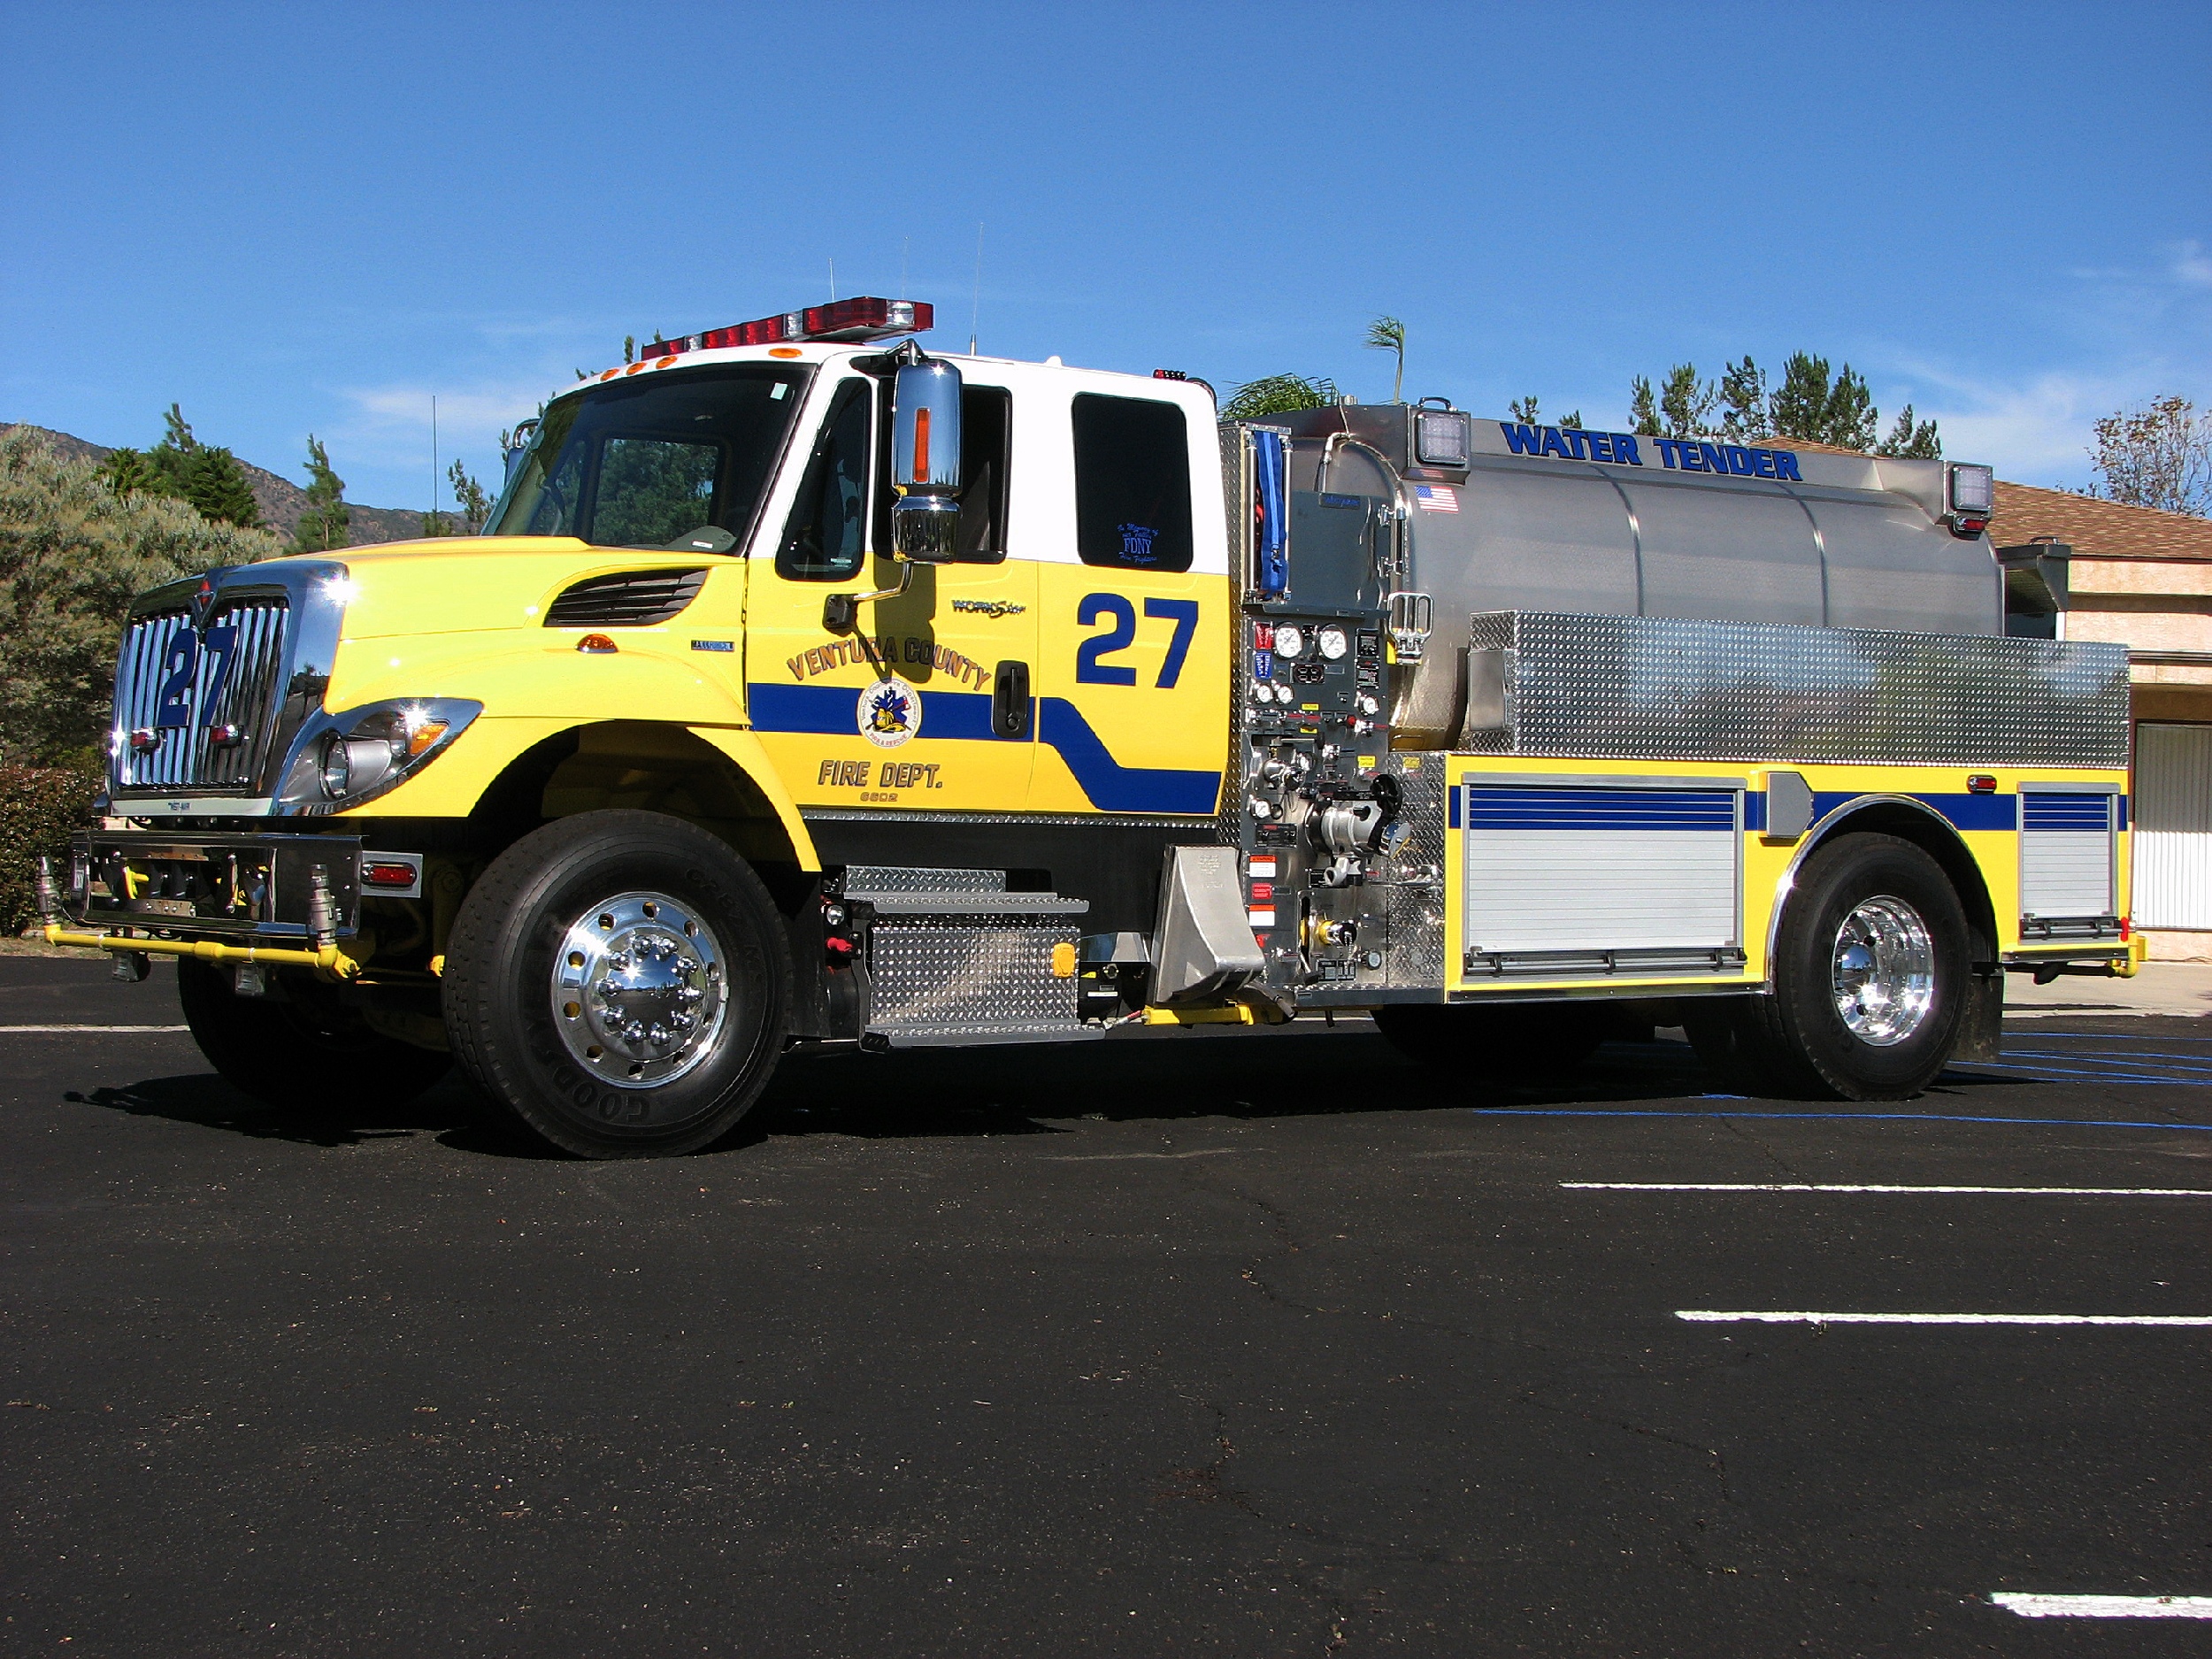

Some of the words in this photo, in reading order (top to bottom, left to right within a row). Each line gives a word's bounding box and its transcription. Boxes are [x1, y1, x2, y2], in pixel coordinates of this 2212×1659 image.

[1500, 422, 1643, 465] WATER
[1654, 438, 1803, 481] TENDER
[1123, 537, 1151, 555] FDNY
[787, 636, 899, 681] VENTURA
[904, 636, 992, 691] COUNTY
[1076, 592, 1199, 689] 27
[157, 625, 239, 726] 27
[818, 759, 871, 787] FIRE
[879, 762, 943, 788] DEPT.
[860, 792, 899, 803] 6602
